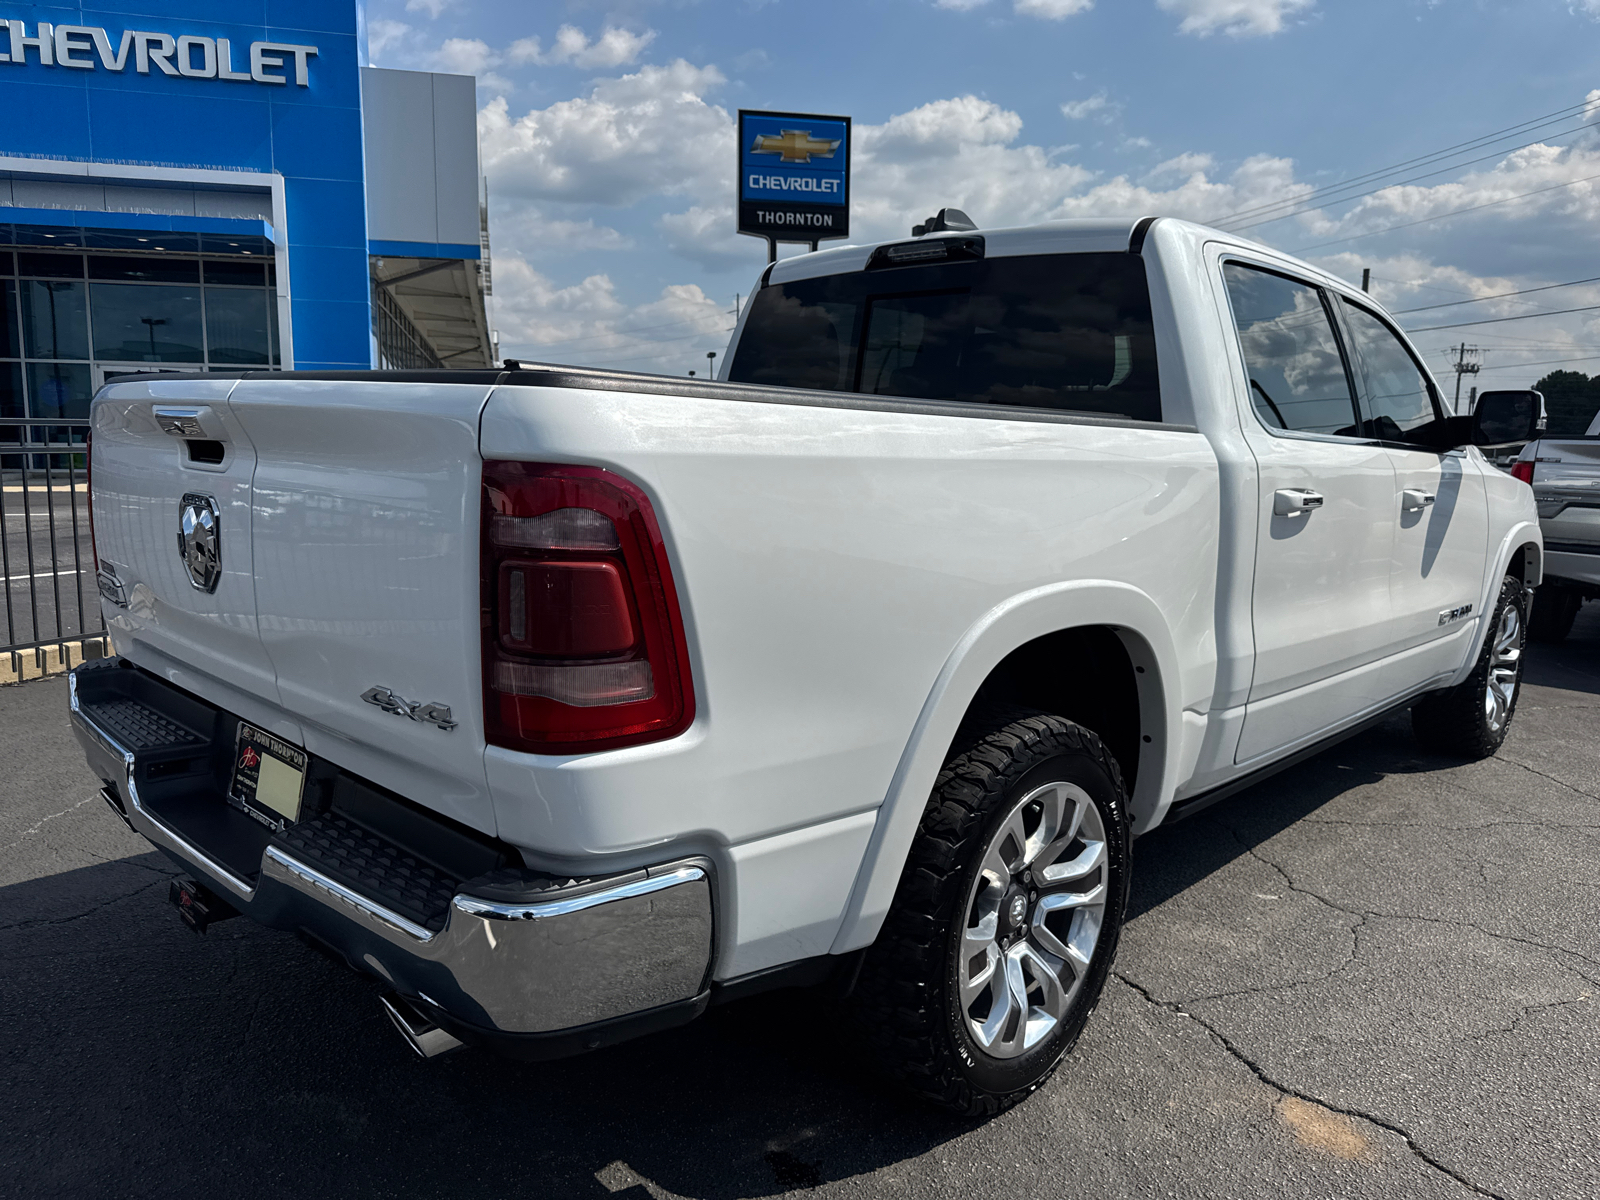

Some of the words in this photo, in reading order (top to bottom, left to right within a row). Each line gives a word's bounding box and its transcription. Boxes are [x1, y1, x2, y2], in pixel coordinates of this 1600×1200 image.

[0, 19, 319, 87] HEVROLET
[749, 174, 840, 193] CHEVROLET
[757, 211, 833, 227] THORNTON
[253, 731, 270, 748] JOHN
[270, 738, 304, 767] THORNTON
